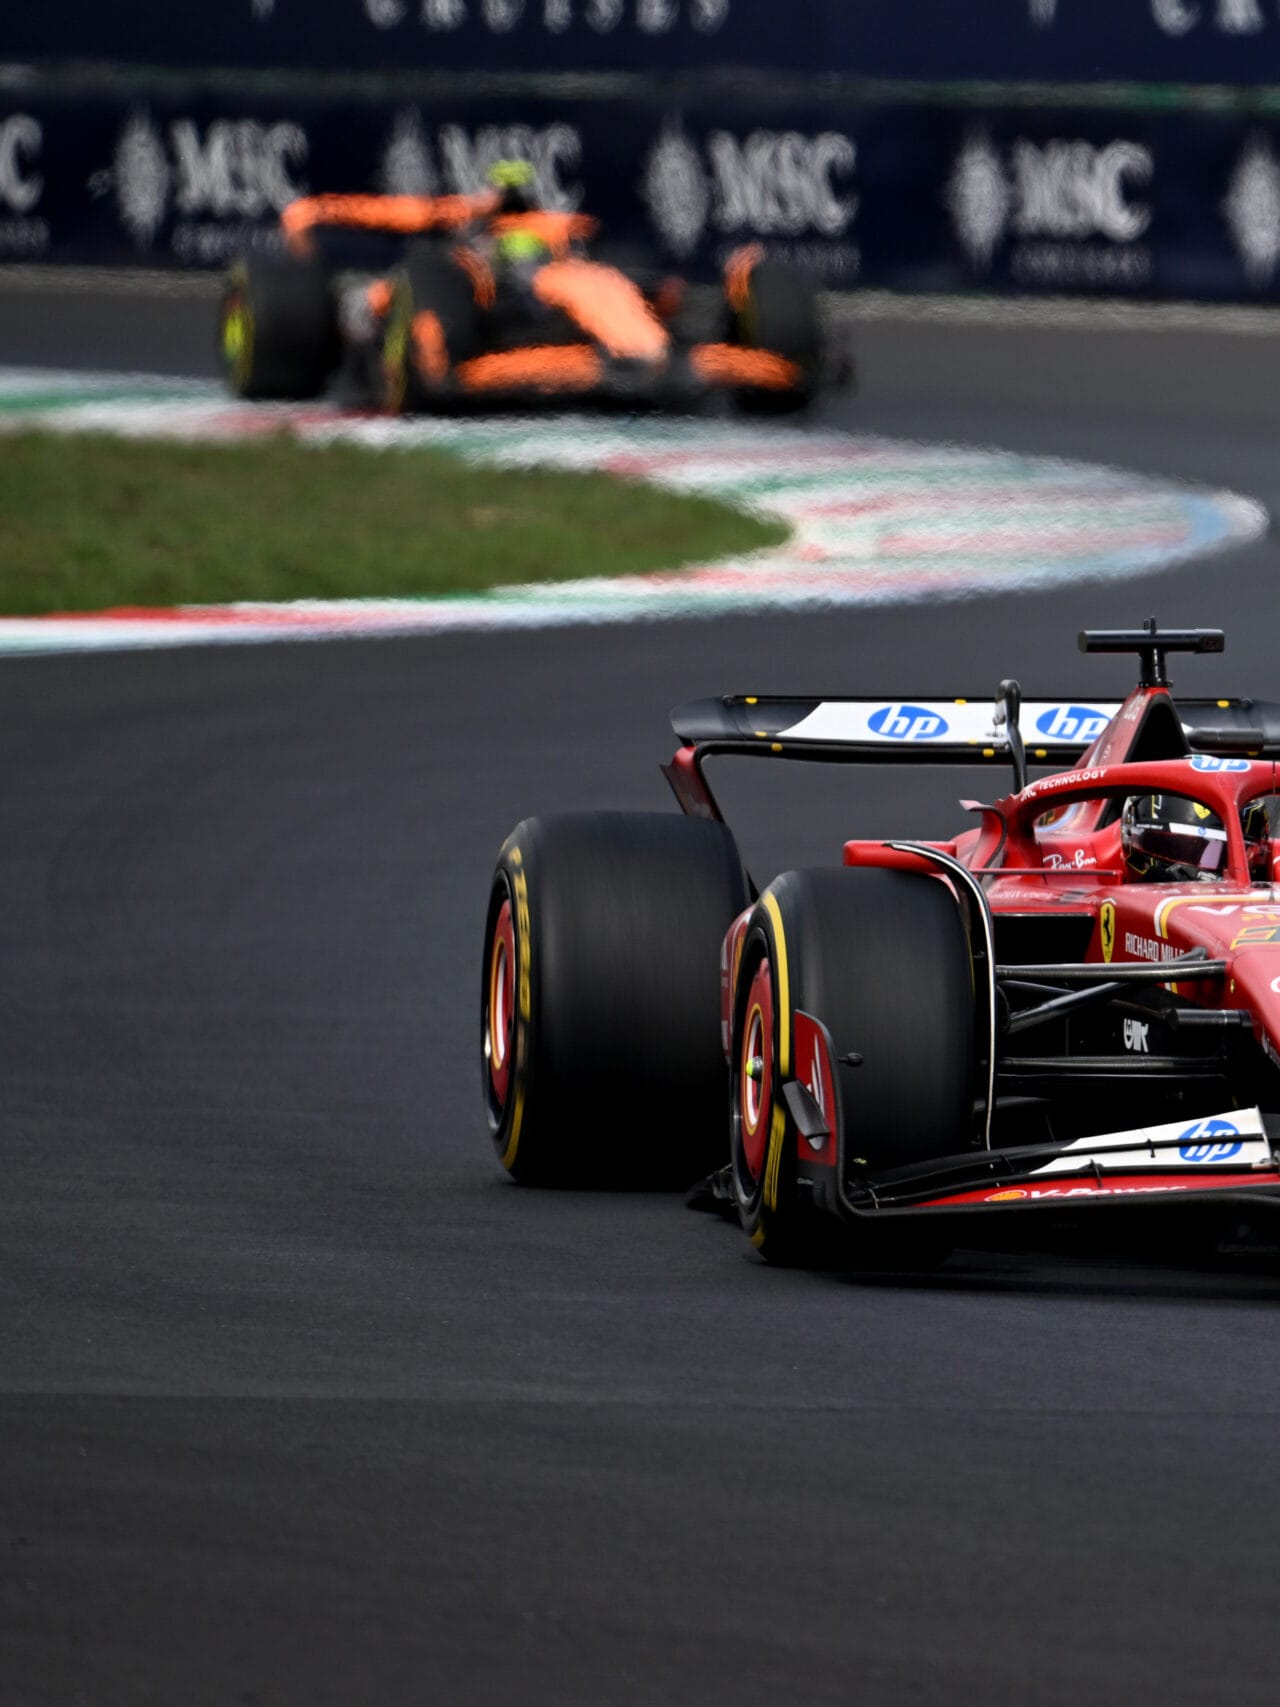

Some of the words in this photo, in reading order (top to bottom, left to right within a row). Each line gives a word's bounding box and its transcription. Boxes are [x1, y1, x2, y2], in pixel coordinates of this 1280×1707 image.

[708, 129, 857, 234] MSC
[1011, 138, 1153, 242] MSC
[874, 704, 944, 740] hp
[1043, 706, 1111, 741] hp
[1039, 768, 1109, 791] TECHNOLOGY
[1042, 848, 1097, 869] Ray-Ban
[1125, 932, 1159, 962] RICHARD
[1181, 1120, 1241, 1162] hp
[1030, 1186, 1187, 1198] V-Power
